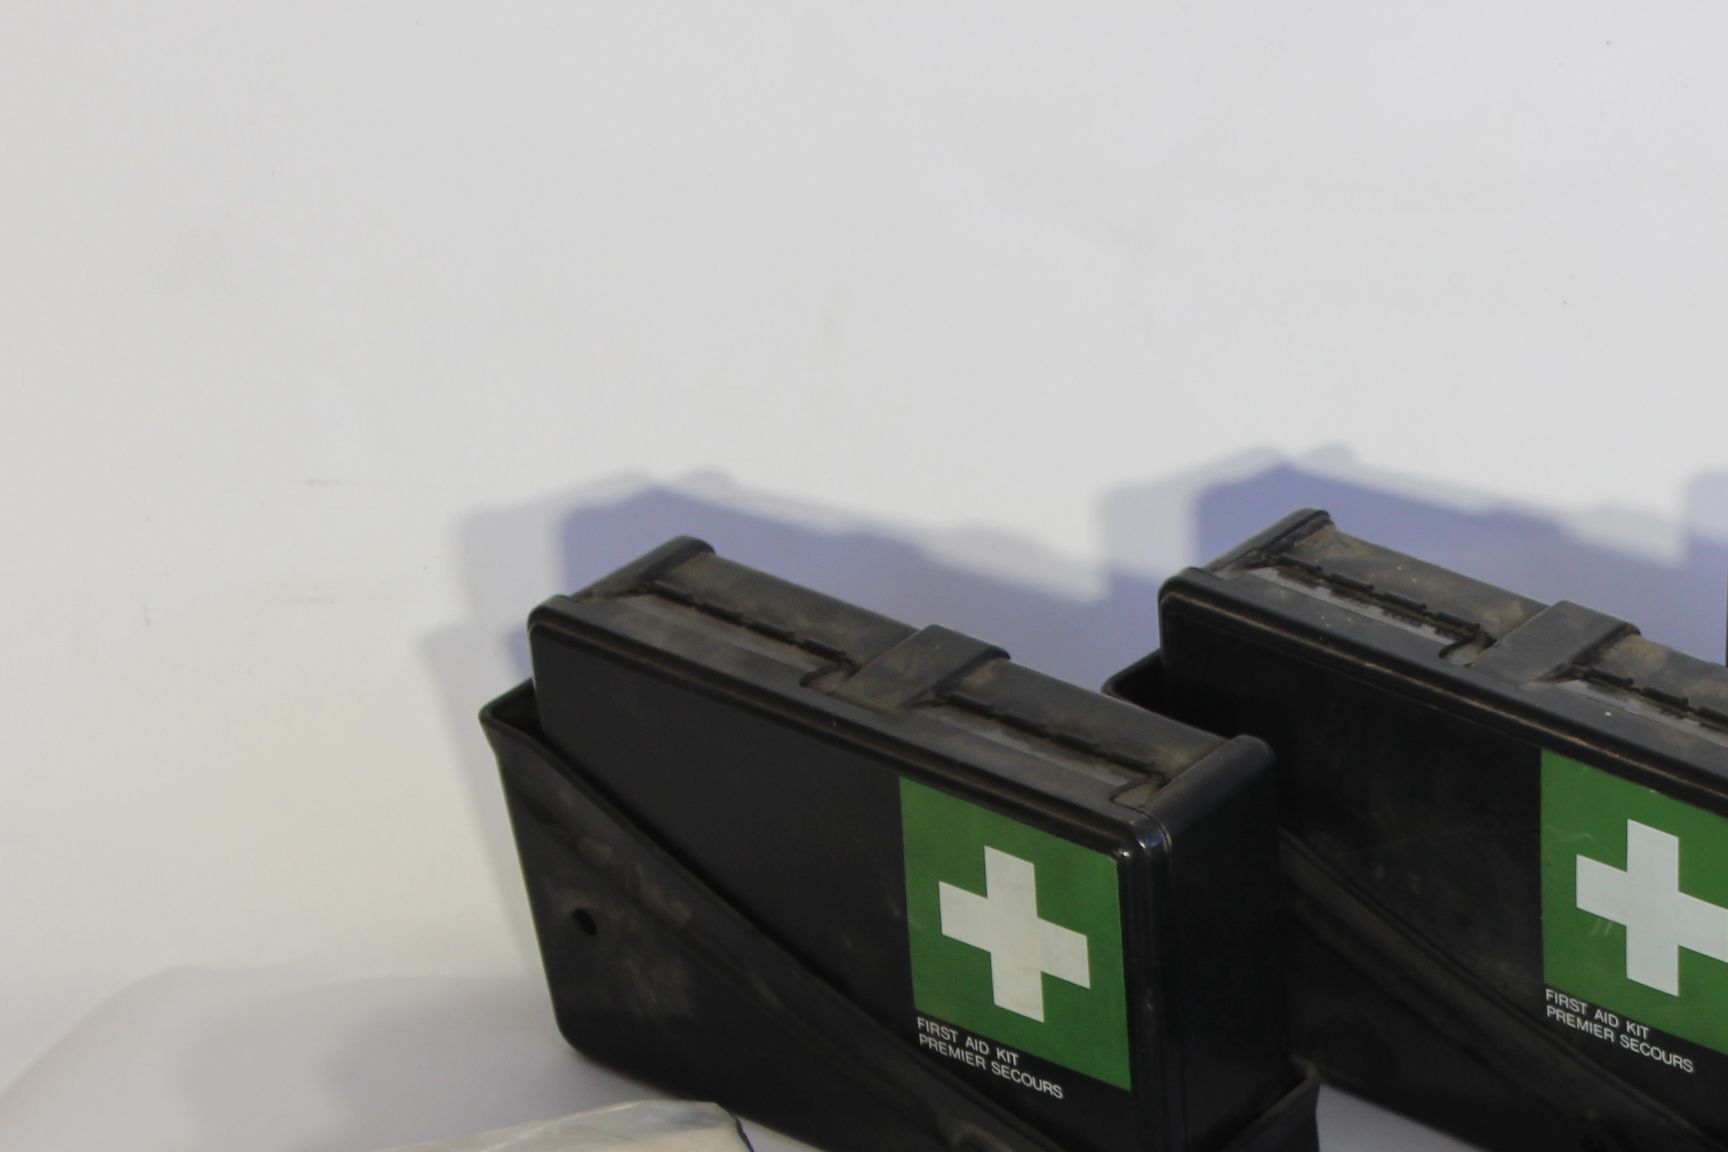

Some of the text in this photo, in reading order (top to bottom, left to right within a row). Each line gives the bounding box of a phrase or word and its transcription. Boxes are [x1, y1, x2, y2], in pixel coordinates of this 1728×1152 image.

[917, 1016, 1020, 1066] FIRST AID KIT
[1545, 988, 1650, 1039] FIRST AID KIT
[1546, 1005, 1695, 1074] PREMIER SECOURS
[918, 1033, 1064, 1099] PREMIER SECOURS
